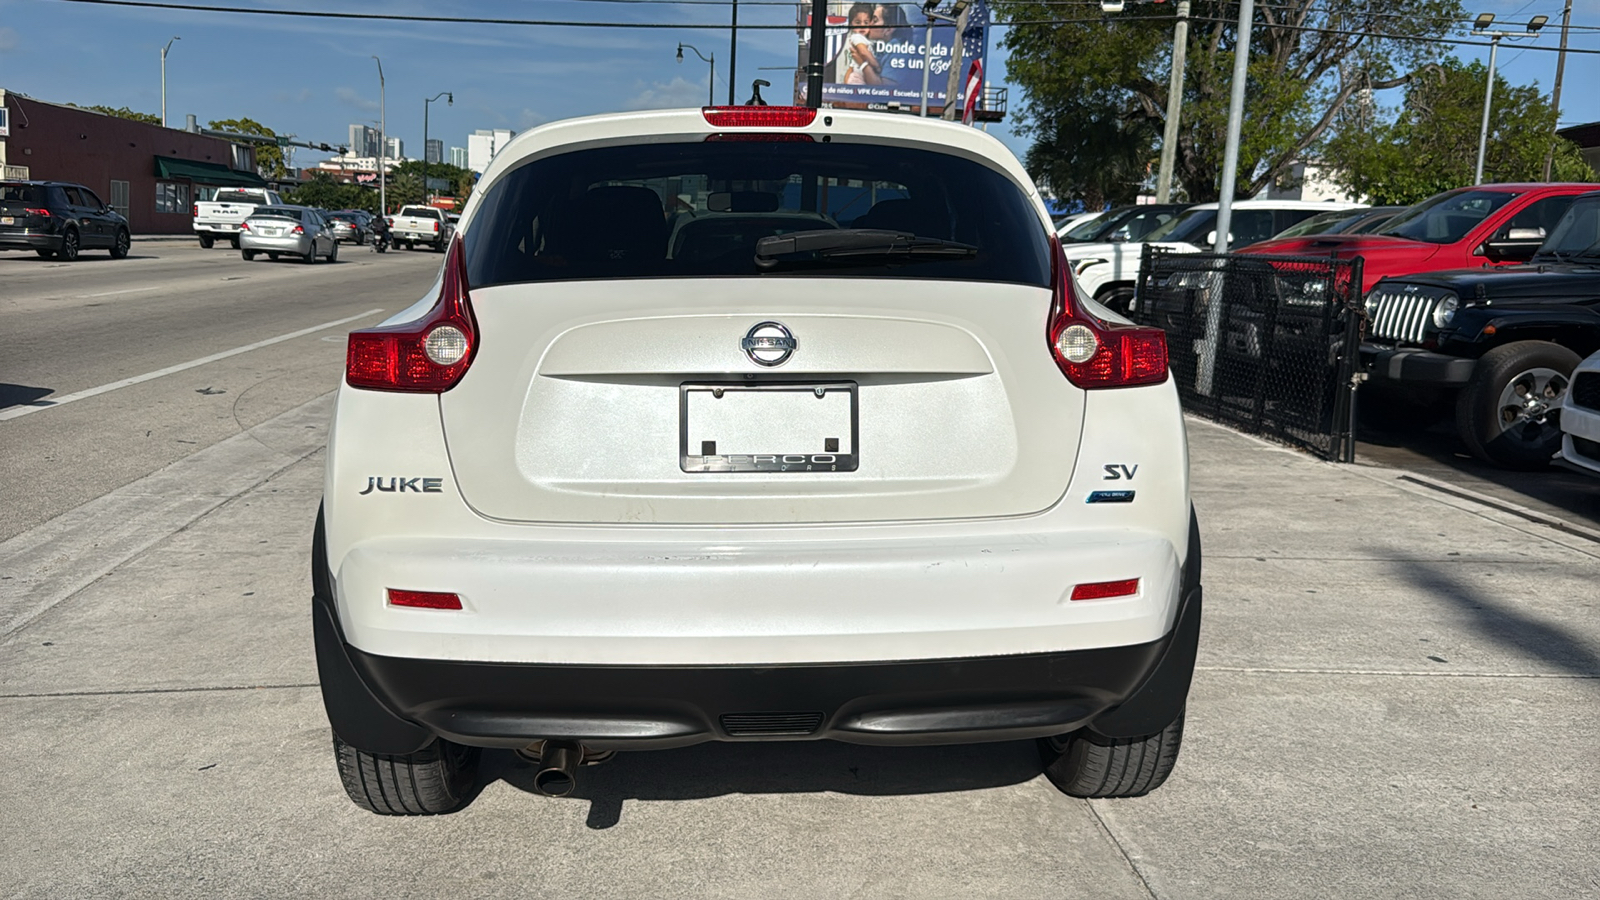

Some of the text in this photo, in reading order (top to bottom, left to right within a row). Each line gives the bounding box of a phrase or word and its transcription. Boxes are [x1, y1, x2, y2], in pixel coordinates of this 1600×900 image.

[876, 40, 916, 55] Donde
[890, 58, 906, 68] es
[908, 58, 924, 69] un
[828, 86, 836, 94] de
[837, 86, 854, 95] niños
[871, 88, 890, 97] Gratis
[893, 90, 920, 98] Escuelas
[747, 338, 791, 348] NISSAN
[1103, 464, 1139, 480] SV
[359, 477, 443, 495] JUKE
